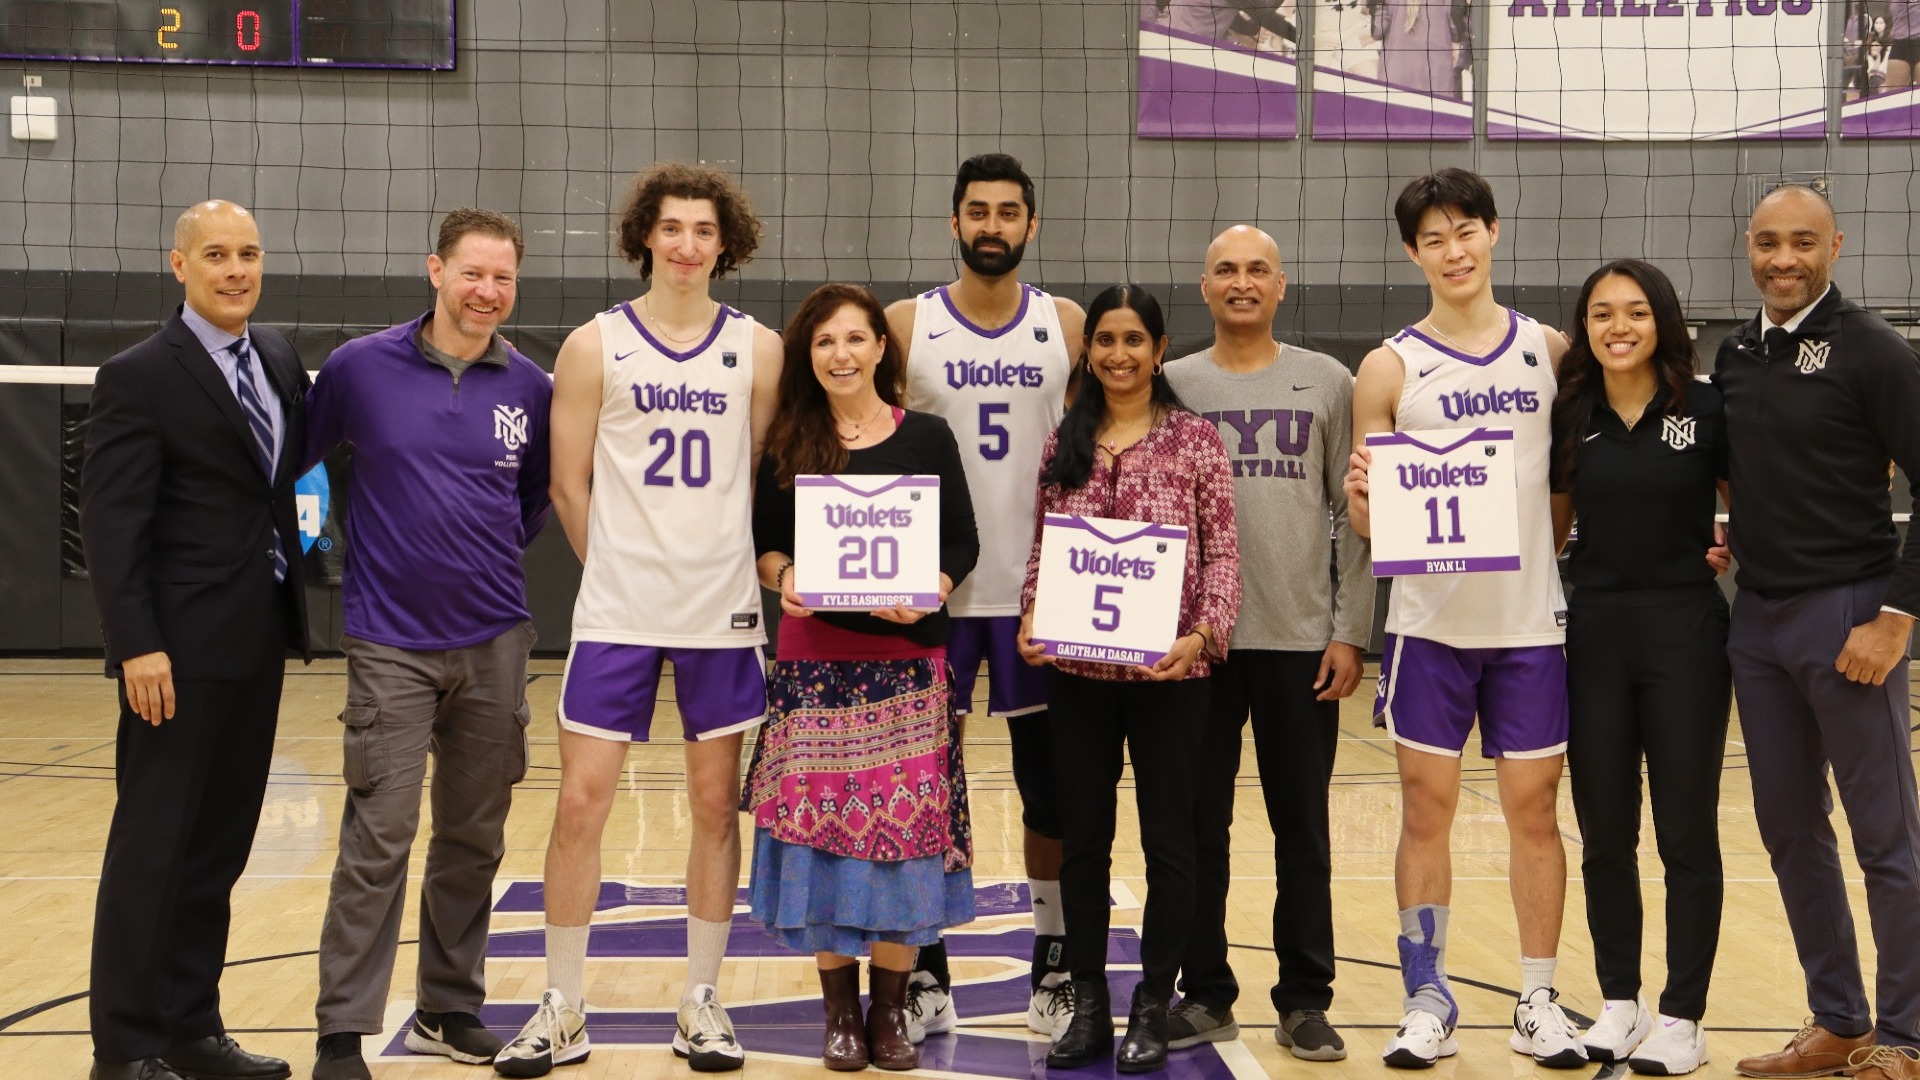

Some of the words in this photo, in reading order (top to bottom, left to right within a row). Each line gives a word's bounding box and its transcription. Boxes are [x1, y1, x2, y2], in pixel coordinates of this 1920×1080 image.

[158, 8, 181, 49] 2
[236, 10, 261, 51] 0
[944, 357, 1044, 391] Violets
[631, 382, 728, 416] Violets
[1438, 385, 1540, 422] Violets
[979, 403, 1010, 461] 5
[643, 427, 712, 488] 20
[1232, 459, 1307, 480] EYBALL
[1396, 461, 1489, 491] Violets
[823, 503, 913, 530] Violets
[1425, 496, 1466, 544] 11
[838, 536, 899, 580] 20
[1068, 546, 1157, 580] Violets
[1426, 561, 1454, 573] RYAN
[1455, 560, 1467, 572] LI
[822, 594, 850, 606] KYLE
[850, 594, 914, 607] RASMUSSEN
[1091, 584, 1123, 632] 5
[1057, 643, 1106, 660] GAUTHAM
[1107, 649, 1145, 664] DASARI
